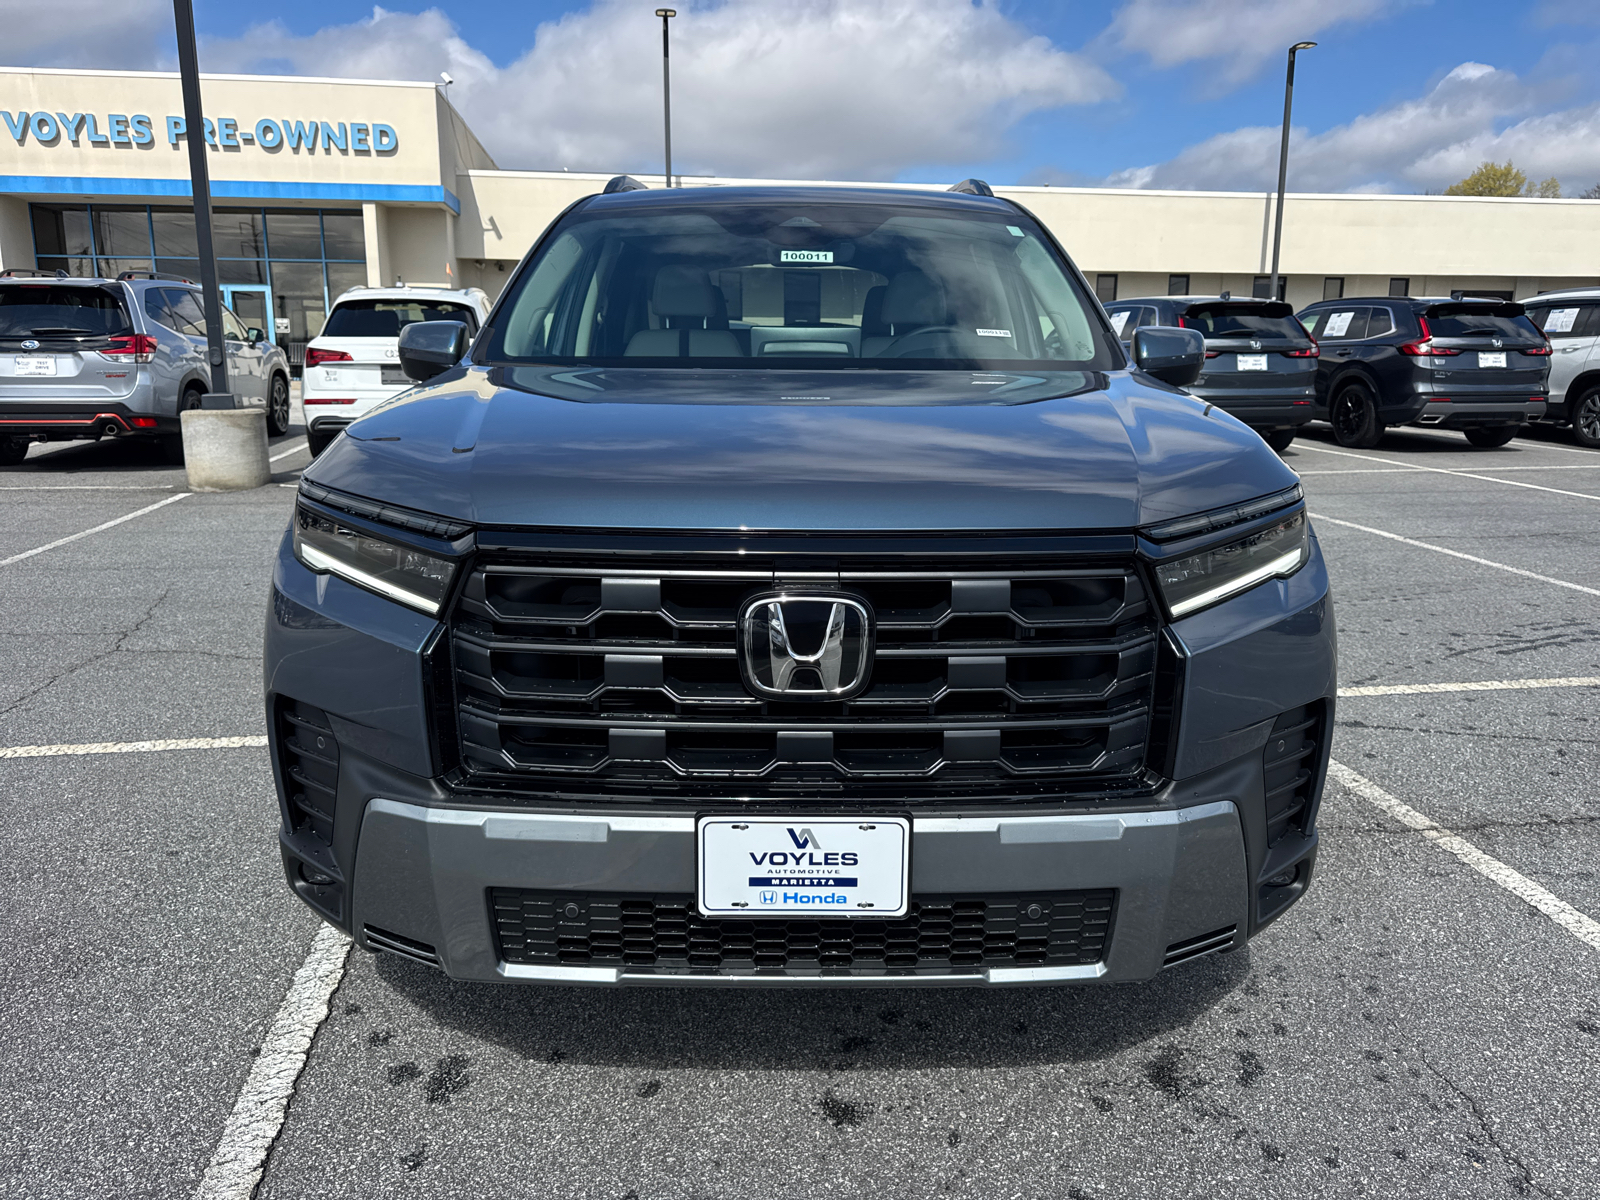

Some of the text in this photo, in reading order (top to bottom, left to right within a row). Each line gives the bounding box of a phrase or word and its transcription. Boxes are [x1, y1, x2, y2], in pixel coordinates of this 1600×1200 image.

[0, 110, 153, 146] VOYLES
[783, 252, 828, 261] 100011
[749, 852, 858, 866] VOYLES
[783, 892, 847, 904] Honda
